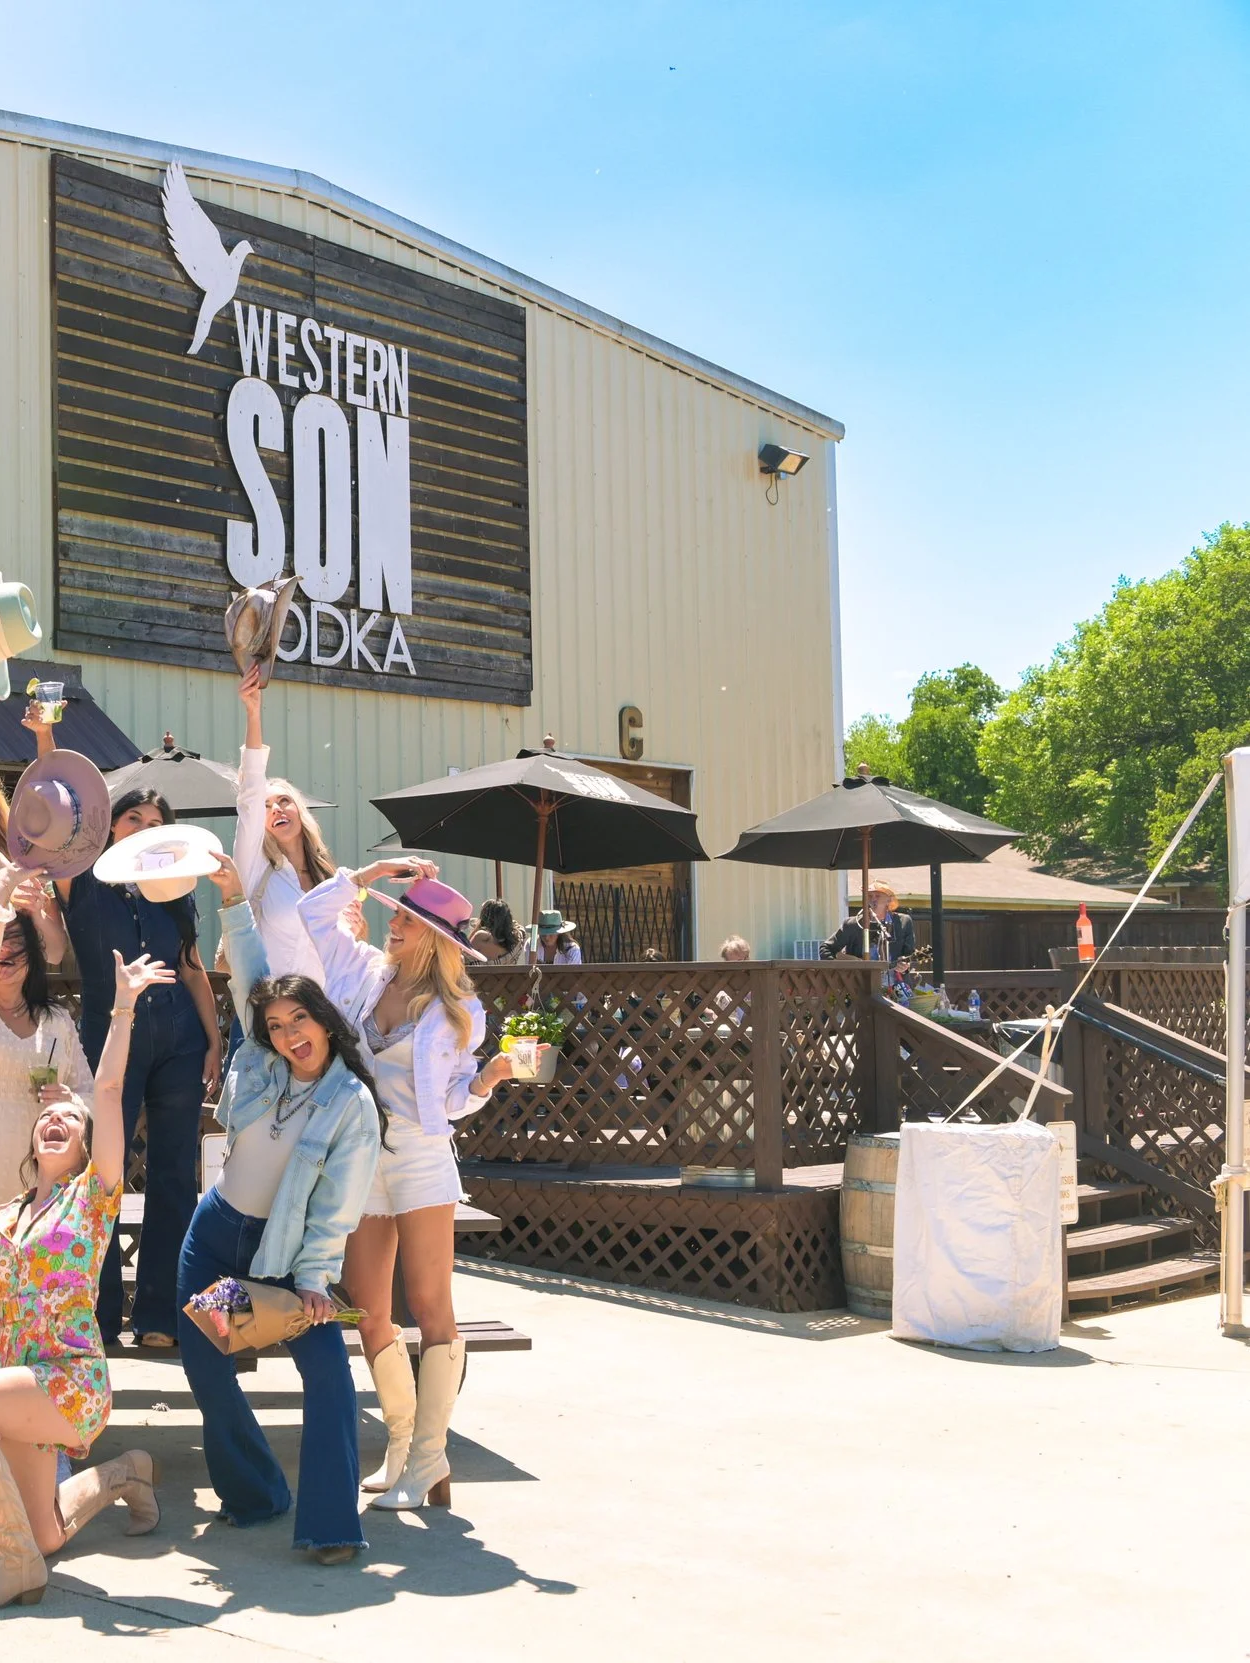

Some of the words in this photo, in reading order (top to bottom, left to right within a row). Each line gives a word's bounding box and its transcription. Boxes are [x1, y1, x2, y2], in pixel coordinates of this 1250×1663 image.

[233, 300, 409, 417] WESTERN
[226, 377, 413, 616] SON
[232, 592, 417, 676] ODKA
[618, 706, 643, 760] C
